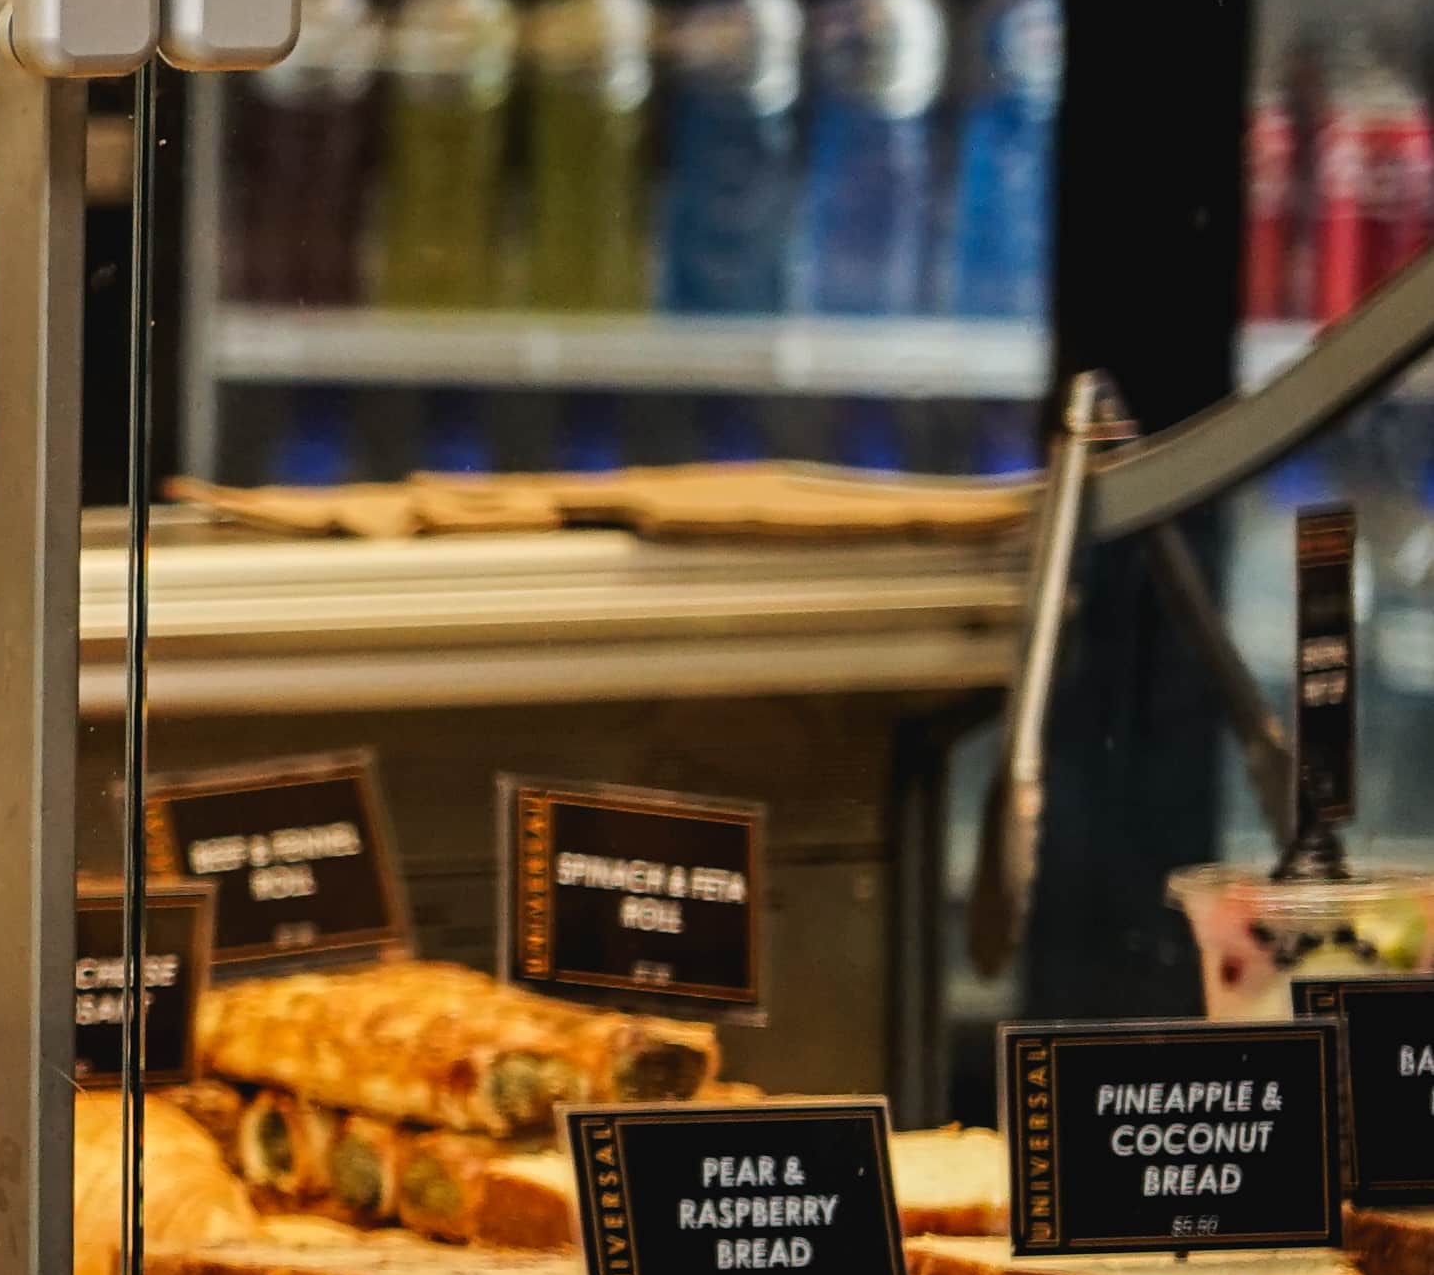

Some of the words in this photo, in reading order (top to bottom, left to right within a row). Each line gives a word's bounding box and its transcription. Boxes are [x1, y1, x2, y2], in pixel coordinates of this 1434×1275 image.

[556, 851, 666, 893] SPINACH
[688, 866, 747, 904] FETA
[1096, 1080, 1255, 1116] PINEAPPLE
[1261, 1081, 1283, 1113] &
[1025, 1046, 1054, 1241] UNIVERSAL
[1111, 1121, 1274, 1157] COCONUT
[702, 1155, 777, 1188] PEAR
[783, 1156, 806, 1186] &
[1142, 1163, 1243, 1197] BREAD
[678, 1194, 840, 1230] RASPBERRY
[715, 1236, 814, 1270] BREAD
